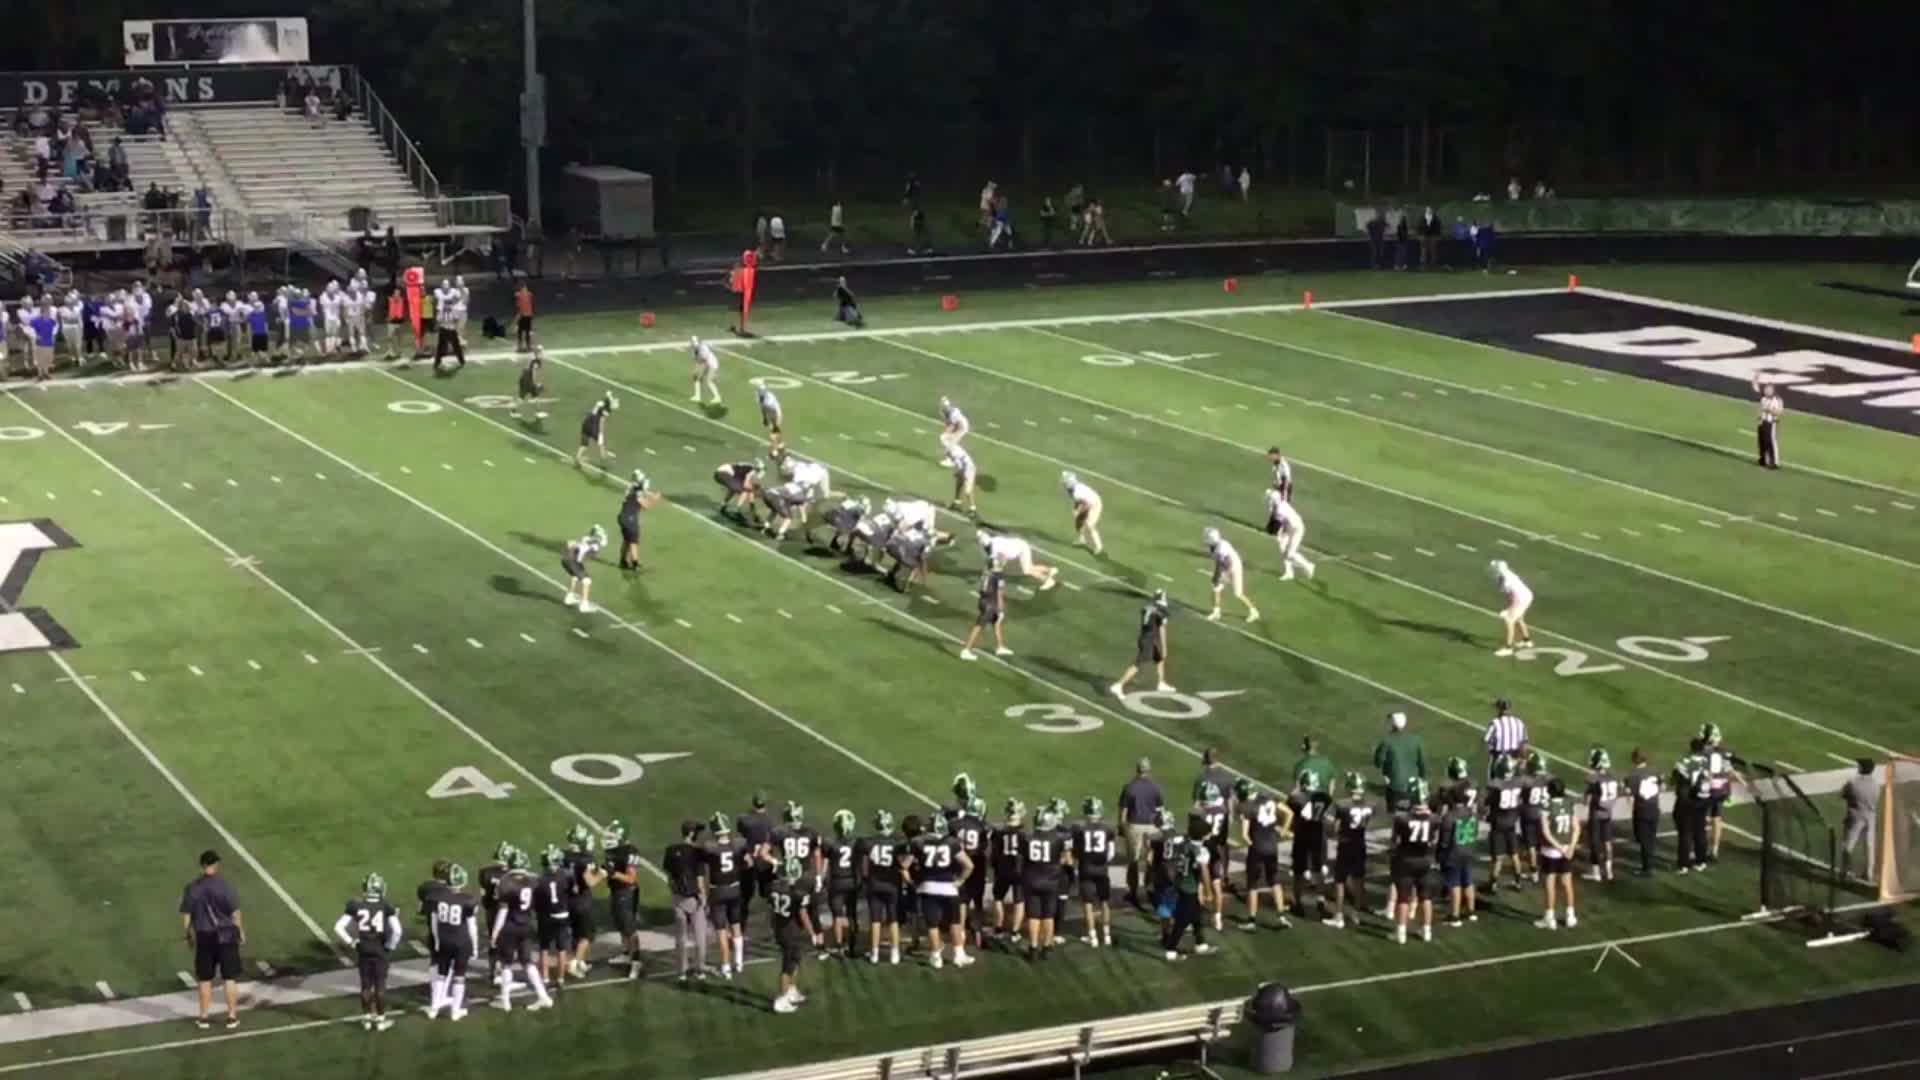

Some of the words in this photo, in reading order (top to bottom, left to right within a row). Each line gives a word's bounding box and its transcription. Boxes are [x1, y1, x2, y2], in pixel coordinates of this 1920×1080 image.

[1084, 830, 1106, 853] 13
[1408, 820, 1430, 843] 71
[783, 837, 809, 859] 86
[839, 846, 852, 868] 2
[869, 844, 895, 867] 45
[923, 845, 951, 867] 73
[1029, 839, 1051, 862] 61
[720, 851, 734, 873] 5
[519, 887, 533, 910] 9
[549, 881, 559, 904] 1
[356, 908, 384, 933] 24
[438, 901, 462, 926] 88
